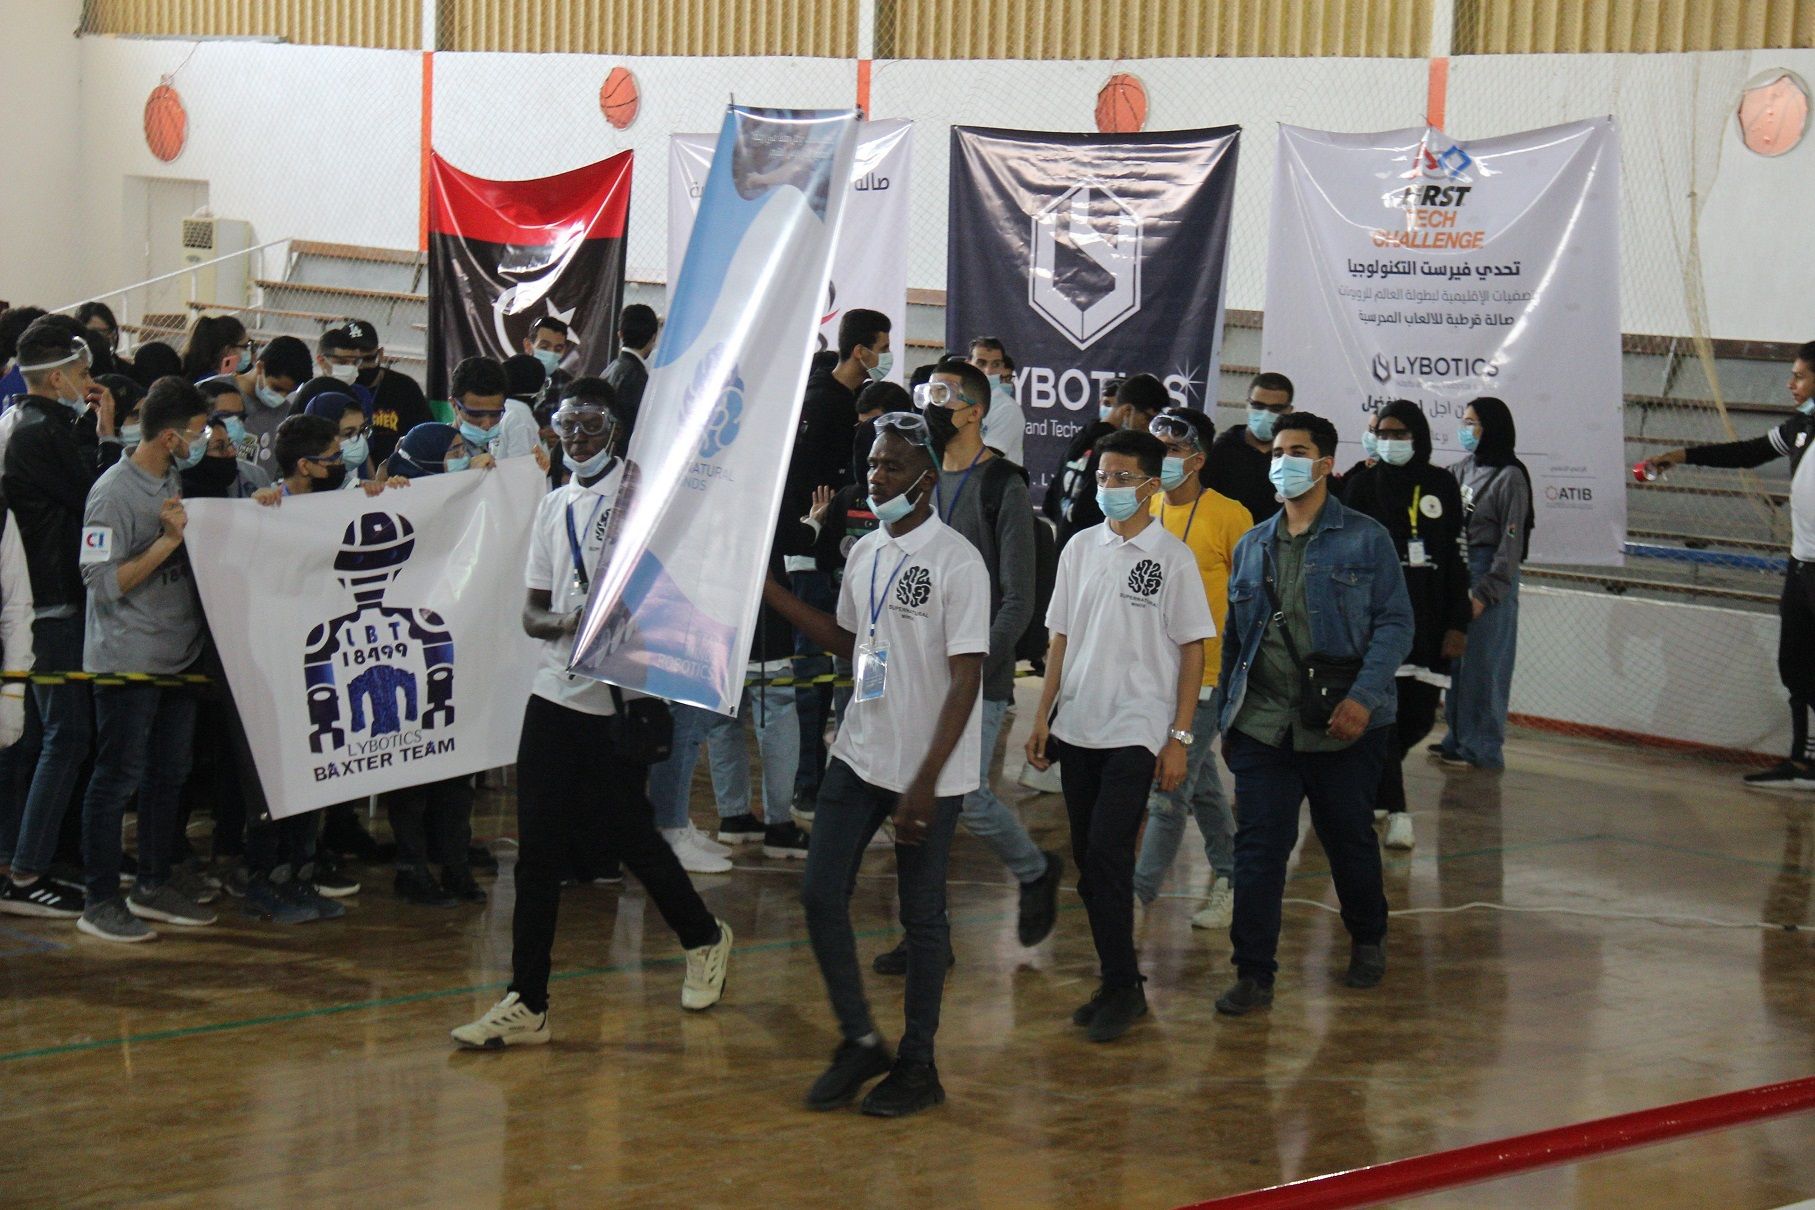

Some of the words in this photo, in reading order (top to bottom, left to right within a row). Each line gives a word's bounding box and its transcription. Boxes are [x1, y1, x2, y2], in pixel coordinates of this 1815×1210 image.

[1407, 208, 1457, 228] ECH
[1372, 230, 1485, 249] CHALLENGE
[1347, 258, 1417, 279] التكنولوجيا
[1420, 261, 1471, 281] فيرست
[1475, 261, 1521, 281] تحدي
[1446, 311, 1482, 329] قرطبة
[1484, 312, 1515, 326] صالة
[1393, 355, 1499, 378] LYBOTICS
[1013, 366, 1188, 412] YBOTS
[1025, 419, 1047, 436] and
[342, 642, 408, 667] 18499
[347, 730, 422, 757] LYBOTICS
[313, 752, 393, 782] BAXTER
[399, 737, 455, 762] TEAM
